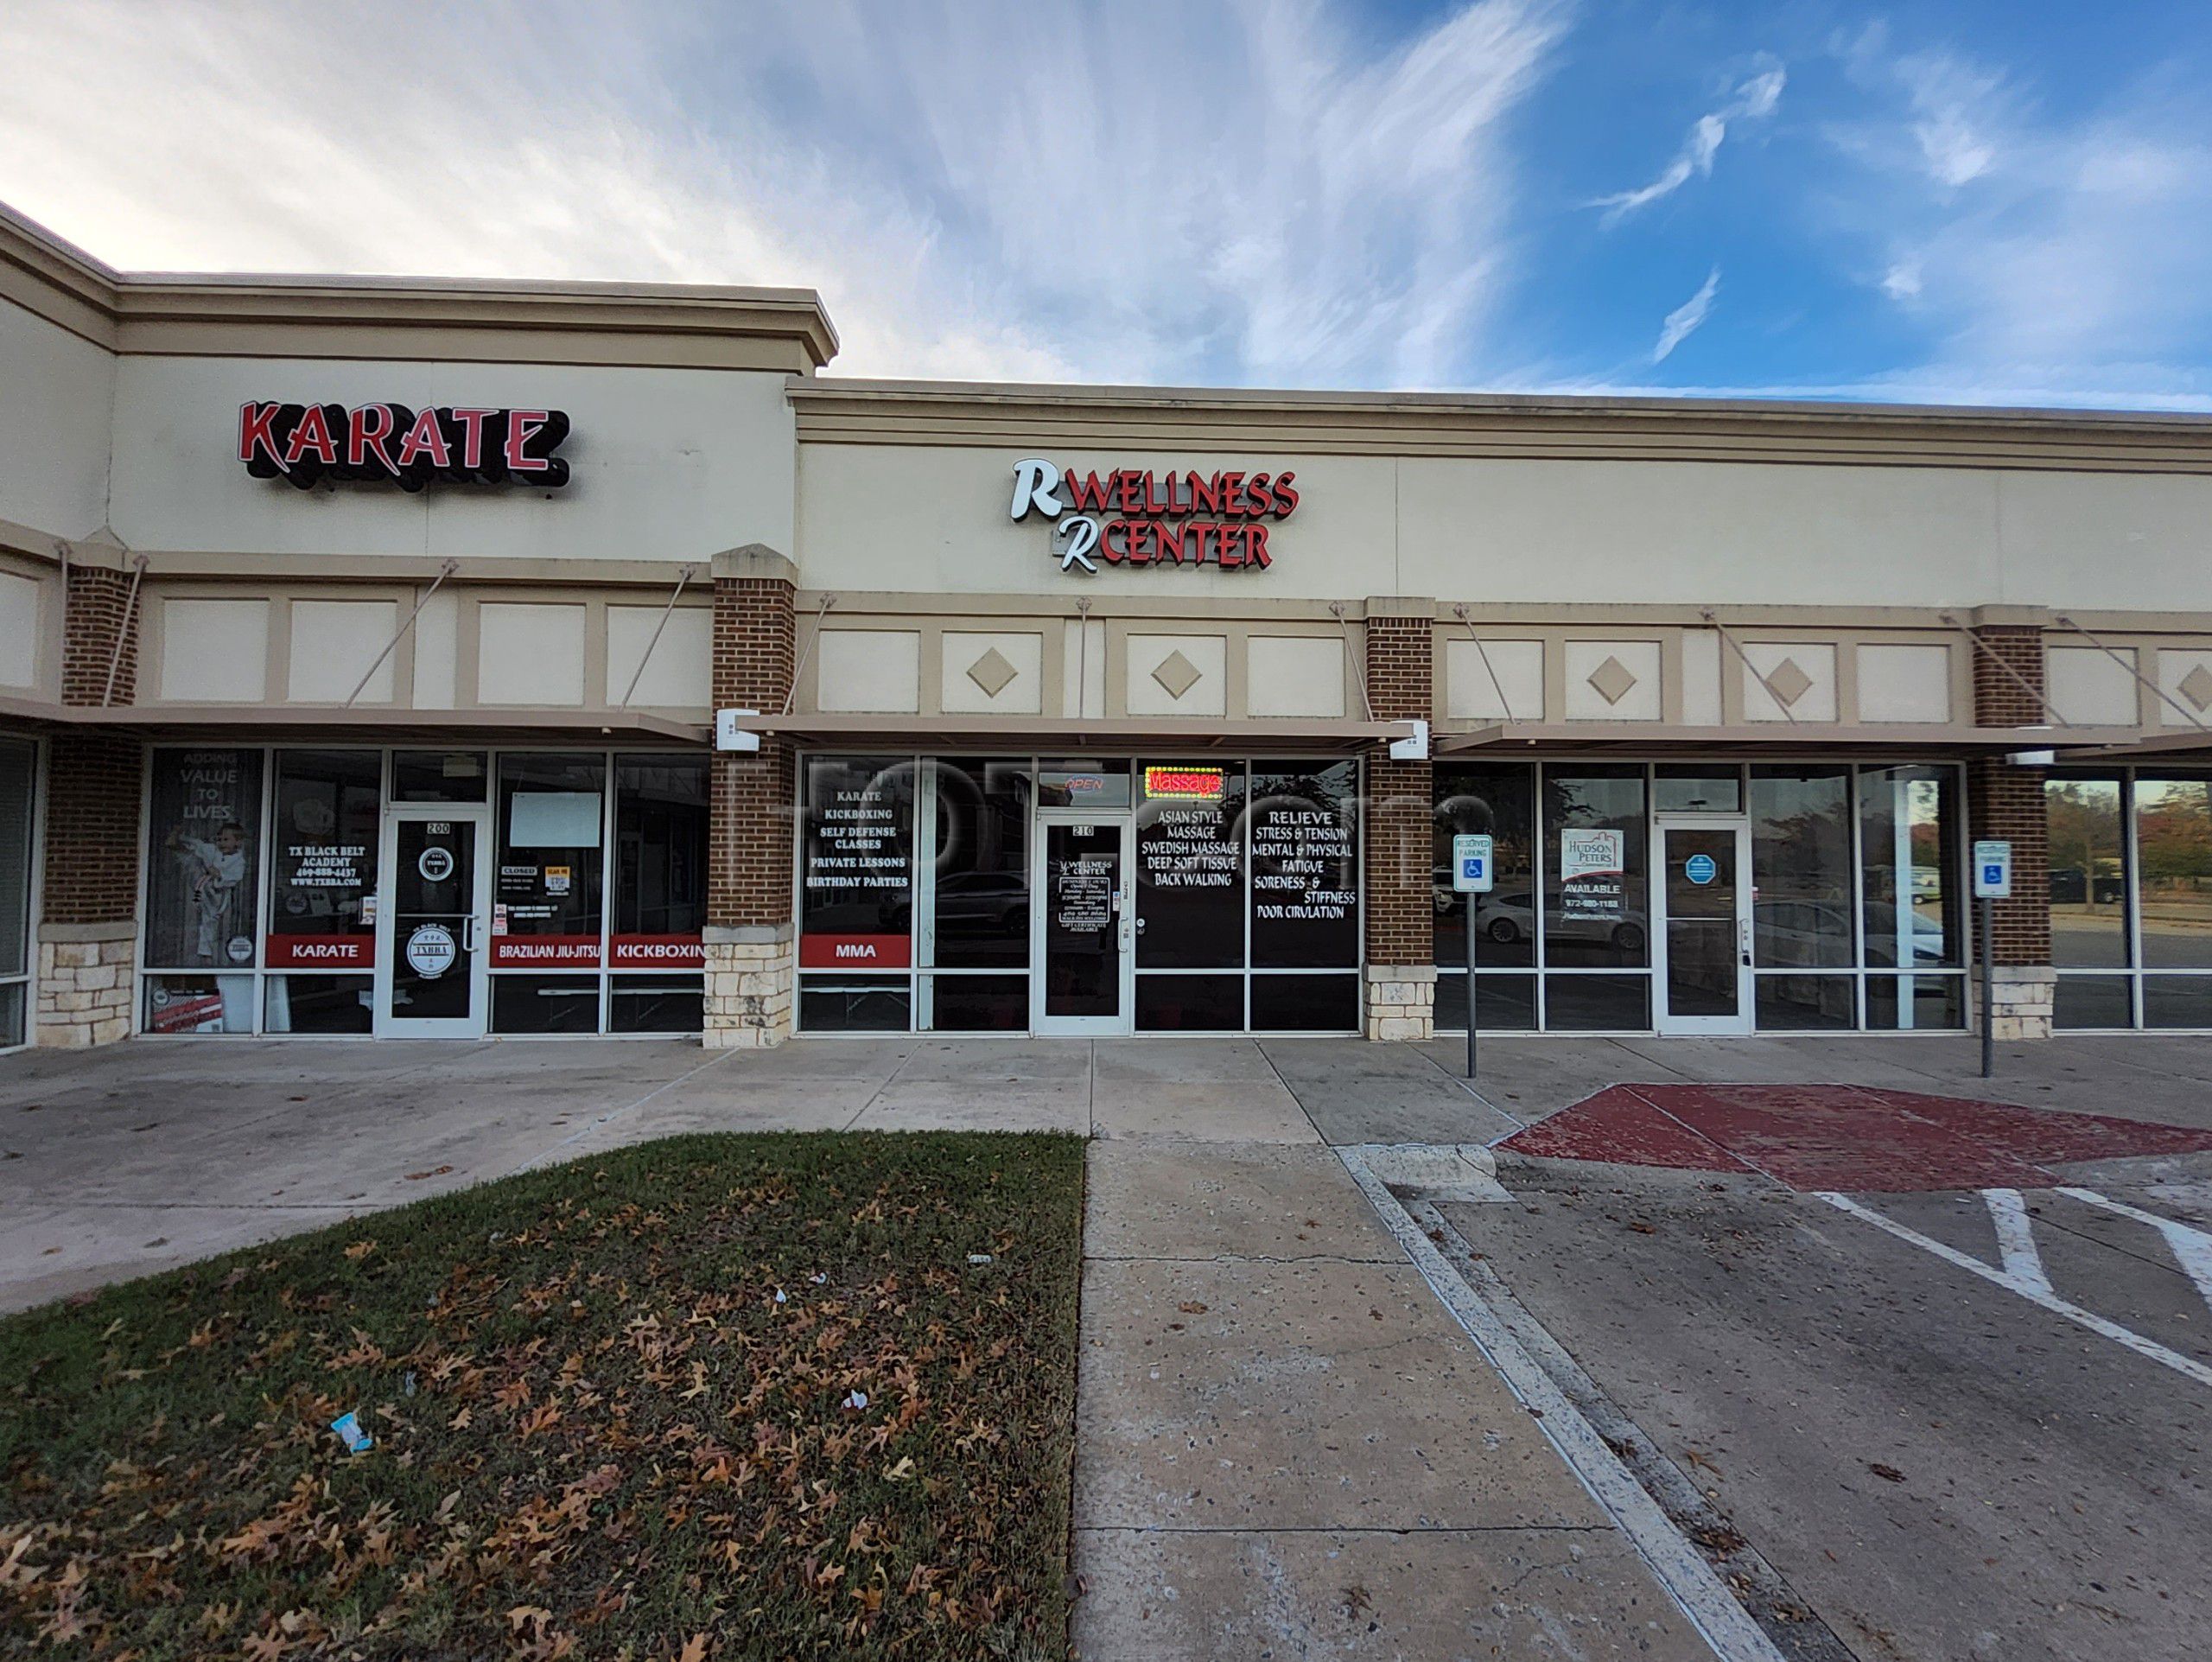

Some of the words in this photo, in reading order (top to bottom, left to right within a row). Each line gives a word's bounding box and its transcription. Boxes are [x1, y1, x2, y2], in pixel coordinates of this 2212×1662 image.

[238, 400, 550, 477] KARATE
[1065, 468, 1300, 519] WELLNESS
[1100, 519, 1273, 570] CENTER
[180, 768, 238, 784] VALUE
[1065, 779, 1104, 791] OPEN
[1148, 771, 1221, 798] Massage
[197, 787, 219, 800] TO
[836, 791, 882, 802] KARATE
[182, 806, 233, 819] LIVES
[824, 809, 893, 820] KICKBOXING
[1158, 810, 1190, 824] ASIAN
[1192, 811, 1224, 824] STYLE
[1268, 811, 1333, 825] RELIEVE
[429, 824, 449, 833] 200
[819, 827, 847, 837] SELF
[848, 826, 897, 837] DEFENSE
[1073, 826, 1092, 836] 210
[1166, 825, 1217, 839] MASSAGE
[1255, 826, 1293, 840] STRESS
[1294, 827, 1303, 840] &
[1305, 827, 1348, 841] TENSION
[289, 846, 303, 856] TX
[304, 845, 338, 856] BLACK
[340, 845, 365, 856] BELT
[835, 838, 882, 850] CLASSES
[1141, 841, 1189, 855] SWEDISH
[1191, 841, 1240, 855] MASSAGE
[1251, 843, 1295, 856] MENTAL
[1296, 844, 1305, 856] &
[1306, 844, 1353, 857] PHYSICAL
[1569, 840, 1612, 853] HUDSON
[302, 856, 352, 867] ACADEMY
[810, 857, 857, 868] PRIVATE
[858, 857, 906, 868] LESSONS
[1147, 856, 1173, 869] DEEP
[1173, 856, 1199, 869] SOFT
[1201, 856, 1237, 870] TISSUE
[1579, 852, 1612, 863] PETERS
[1282, 860, 1325, 873] FATIGUE
[806, 876, 861, 887] BIRTHDAY
[862, 876, 909, 888] PARTIES
[1154, 873, 1181, 886] BACK
[1182, 873, 1232, 886] WALKING
[1255, 876, 1306, 889] SORENESS
[1312, 876, 1321, 889] &
[1564, 883, 1621, 895] AVAILABLE
[1304, 890, 1356, 905] STIFFNESS
[1257, 905, 1284, 919] POOR
[1285, 905, 1344, 919] CIRULATION
[292, 944, 359, 958] KARATE
[499, 945, 555, 958] BRAZILIAN
[556, 945, 601, 958] JIU-JITSU
[836, 944, 876, 958] MMA
